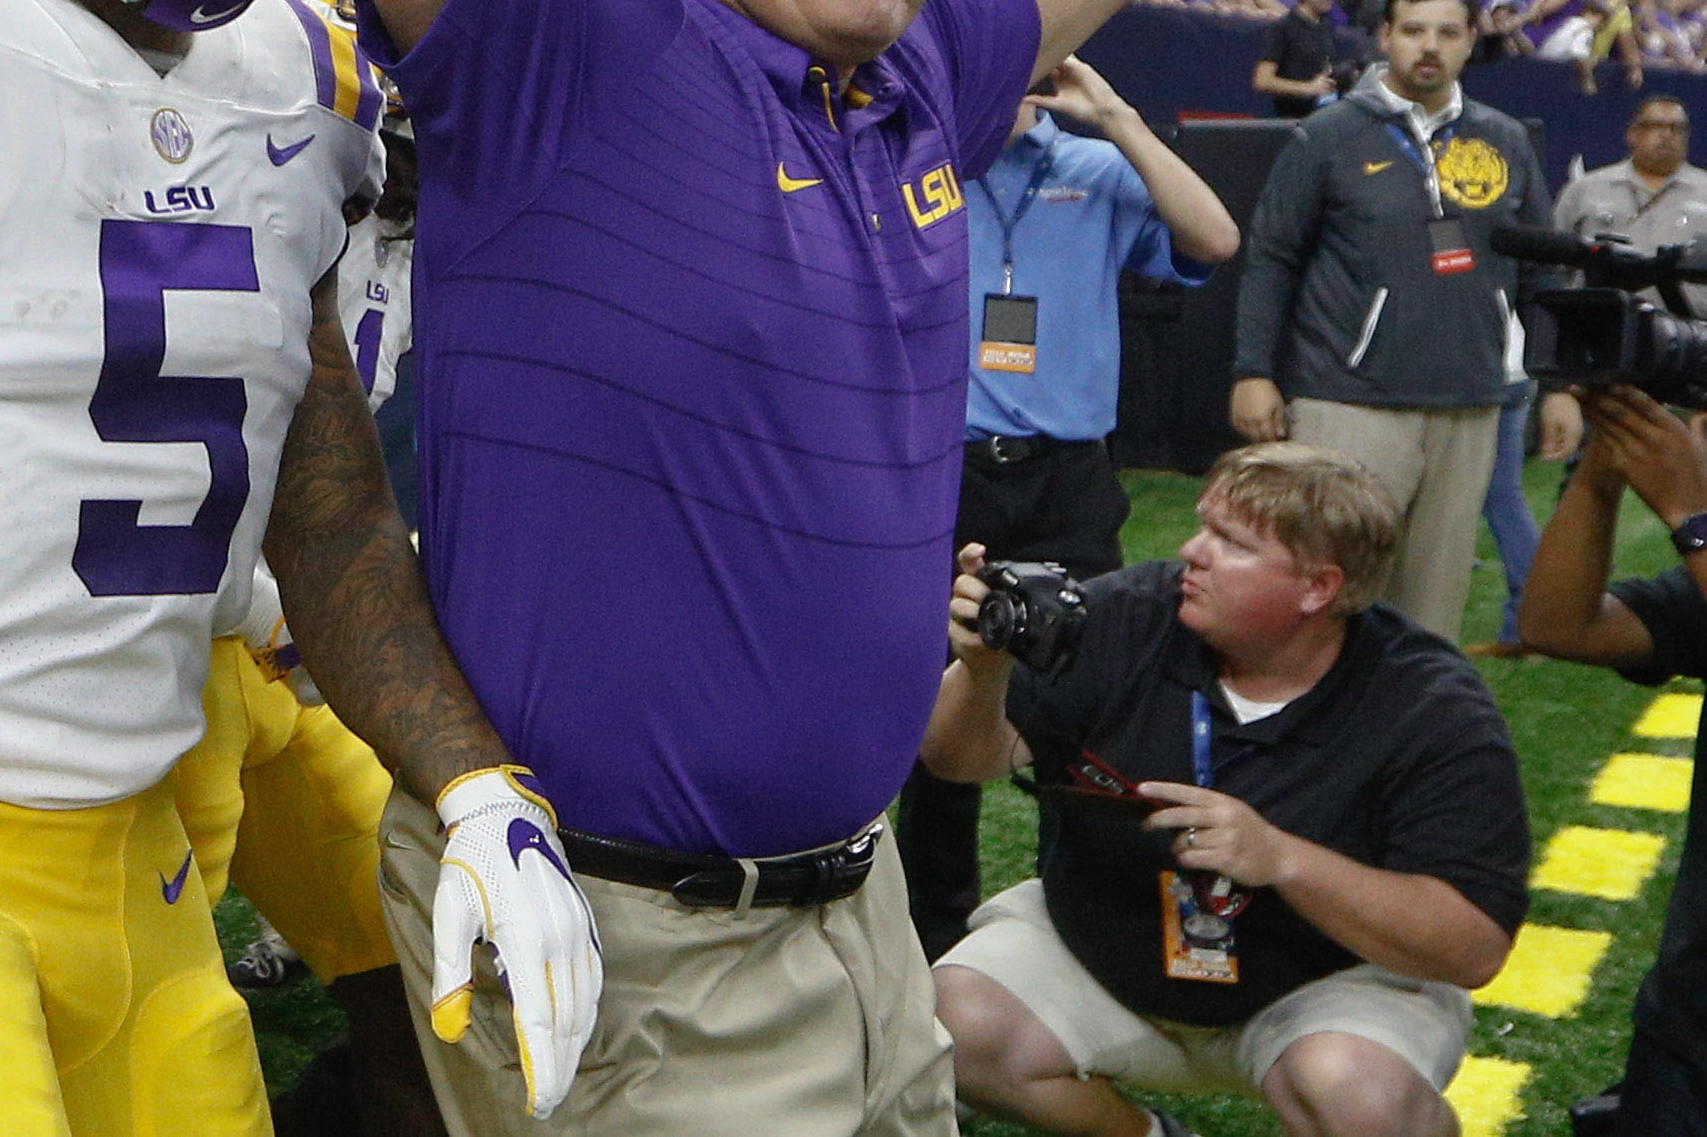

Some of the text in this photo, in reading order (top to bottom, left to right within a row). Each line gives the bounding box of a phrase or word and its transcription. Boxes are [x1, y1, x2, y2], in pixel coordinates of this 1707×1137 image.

[143, 184, 215, 215] LSU
[902, 162, 965, 229] LSU
[71, 218, 261, 598] 5
